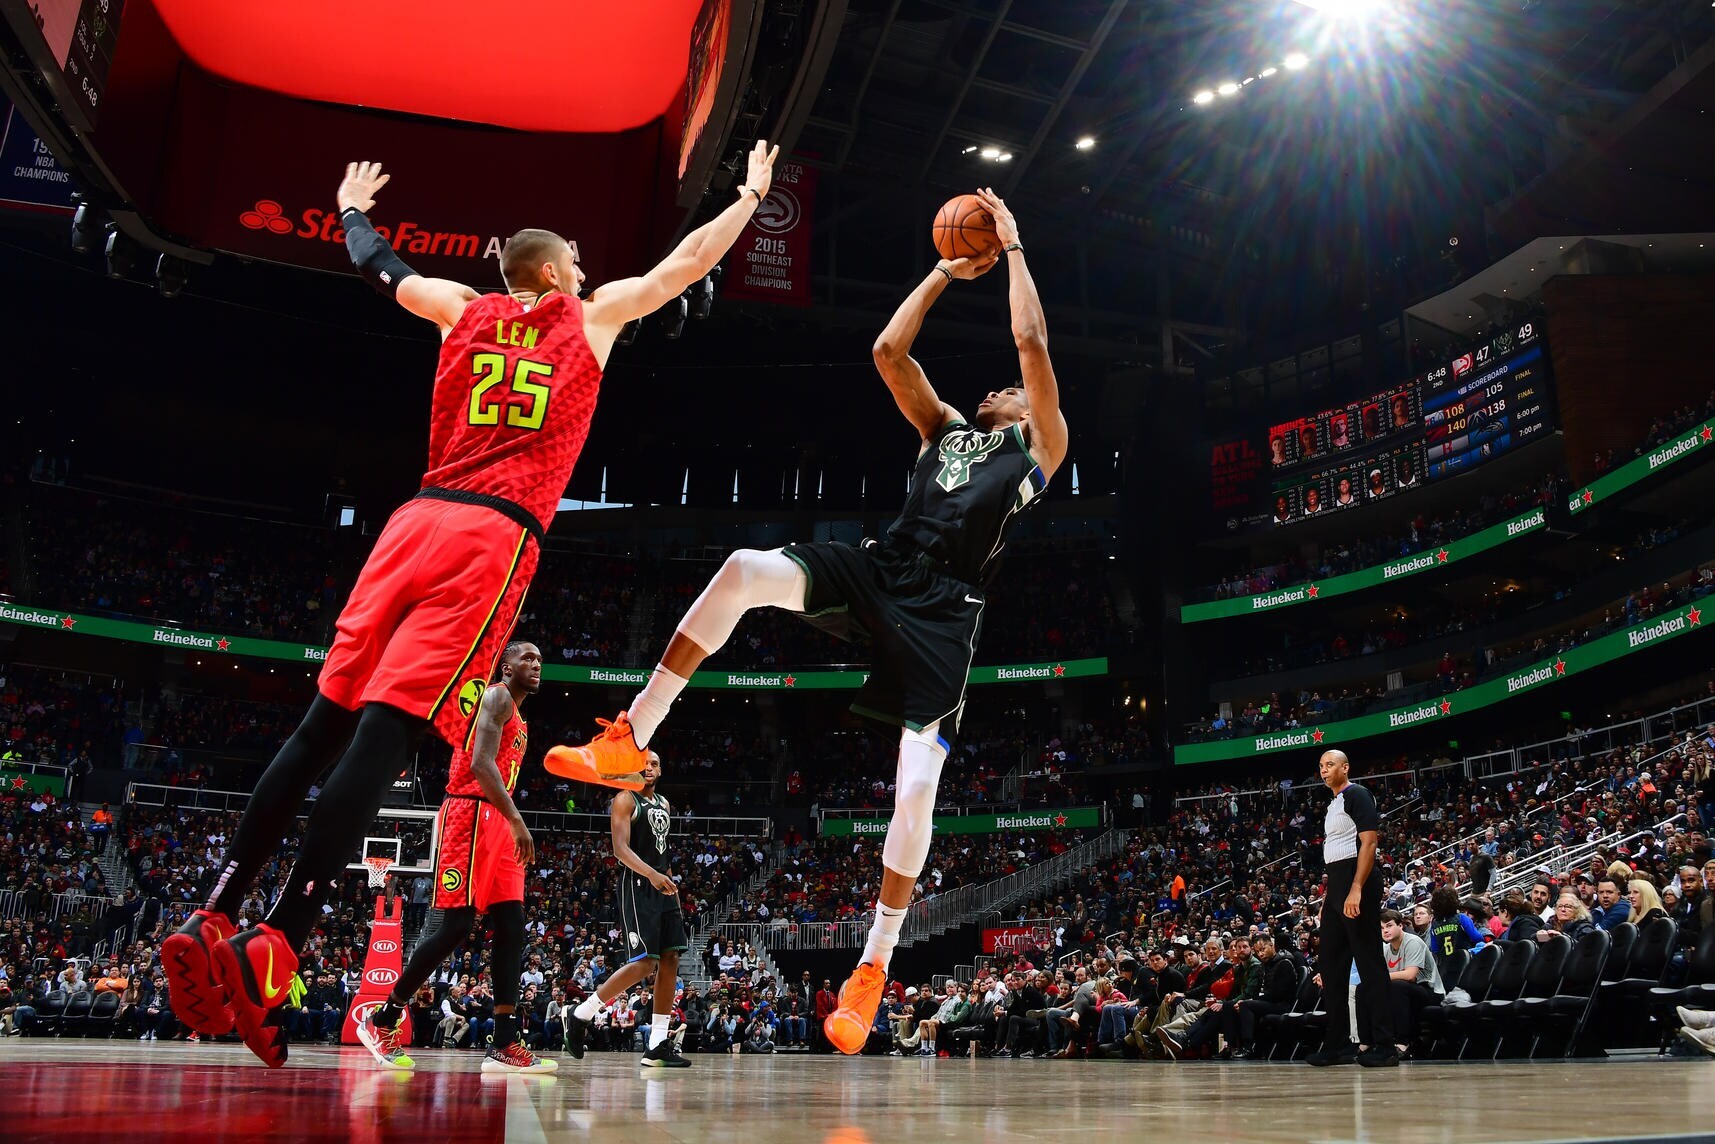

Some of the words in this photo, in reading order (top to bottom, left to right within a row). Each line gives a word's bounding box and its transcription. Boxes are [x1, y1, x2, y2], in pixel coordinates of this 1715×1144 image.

[83, 77, 98, 107] 6:48
[35, 156, 55, 168] NBA
[14, 166, 70, 183] CHAMPIONS
[392, 221, 480, 257] Farm
[755, 237, 786, 254] 2015
[747, 252, 792, 267] SOUTHEAST
[752, 264, 786, 278] DIVISION
[744, 275, 792, 290] CHAMPIONS
[496, 319, 540, 350] LEN
[1518, 323, 1533, 340] 49
[1476, 345, 1489, 361] 47
[1427, 367, 1446, 382] 6:48
[1468, 365, 1509, 391] SCOREBOARD
[1514, 369, 1533, 382] FINAL
[469, 352, 554, 430] 25
[1516, 388, 1535, 401] FINAL
[1445, 403, 1465, 419] 108
[1485, 382, 1504, 398] 105
[1447, 418, 1467, 434] 140
[1487, 399, 1506, 417] 138
[1516, 409, 1530, 420] 6:00
[1530, 405, 1541, 415] pm
[1519, 427, 1532, 438] 7:00
[1532, 423, 1542, 433] pm
[1649, 434, 1698, 469] Heineken
[1507, 511, 1545, 536] Heinek
[1384, 555, 1434, 578] Heineken
[1253, 591, 1304, 609] Heineken
[153, 630, 213, 649] Heineken
[1628, 615, 1685, 647] Heineken
[590, 670, 644, 683] Heineken
[728, 675, 780, 687] Heineken
[997, 666, 1050, 680] Heineken
[1507, 666, 1552, 692] Heineken
[1390, 705, 1438, 727] Heineken
[1255, 732, 1309, 751] Heineken
[996, 815, 1051, 829] Heineken
[376, 942, 393, 951] KIA
[1443, 935, 1455, 956] 6
[371, 972, 393, 982] KIA
